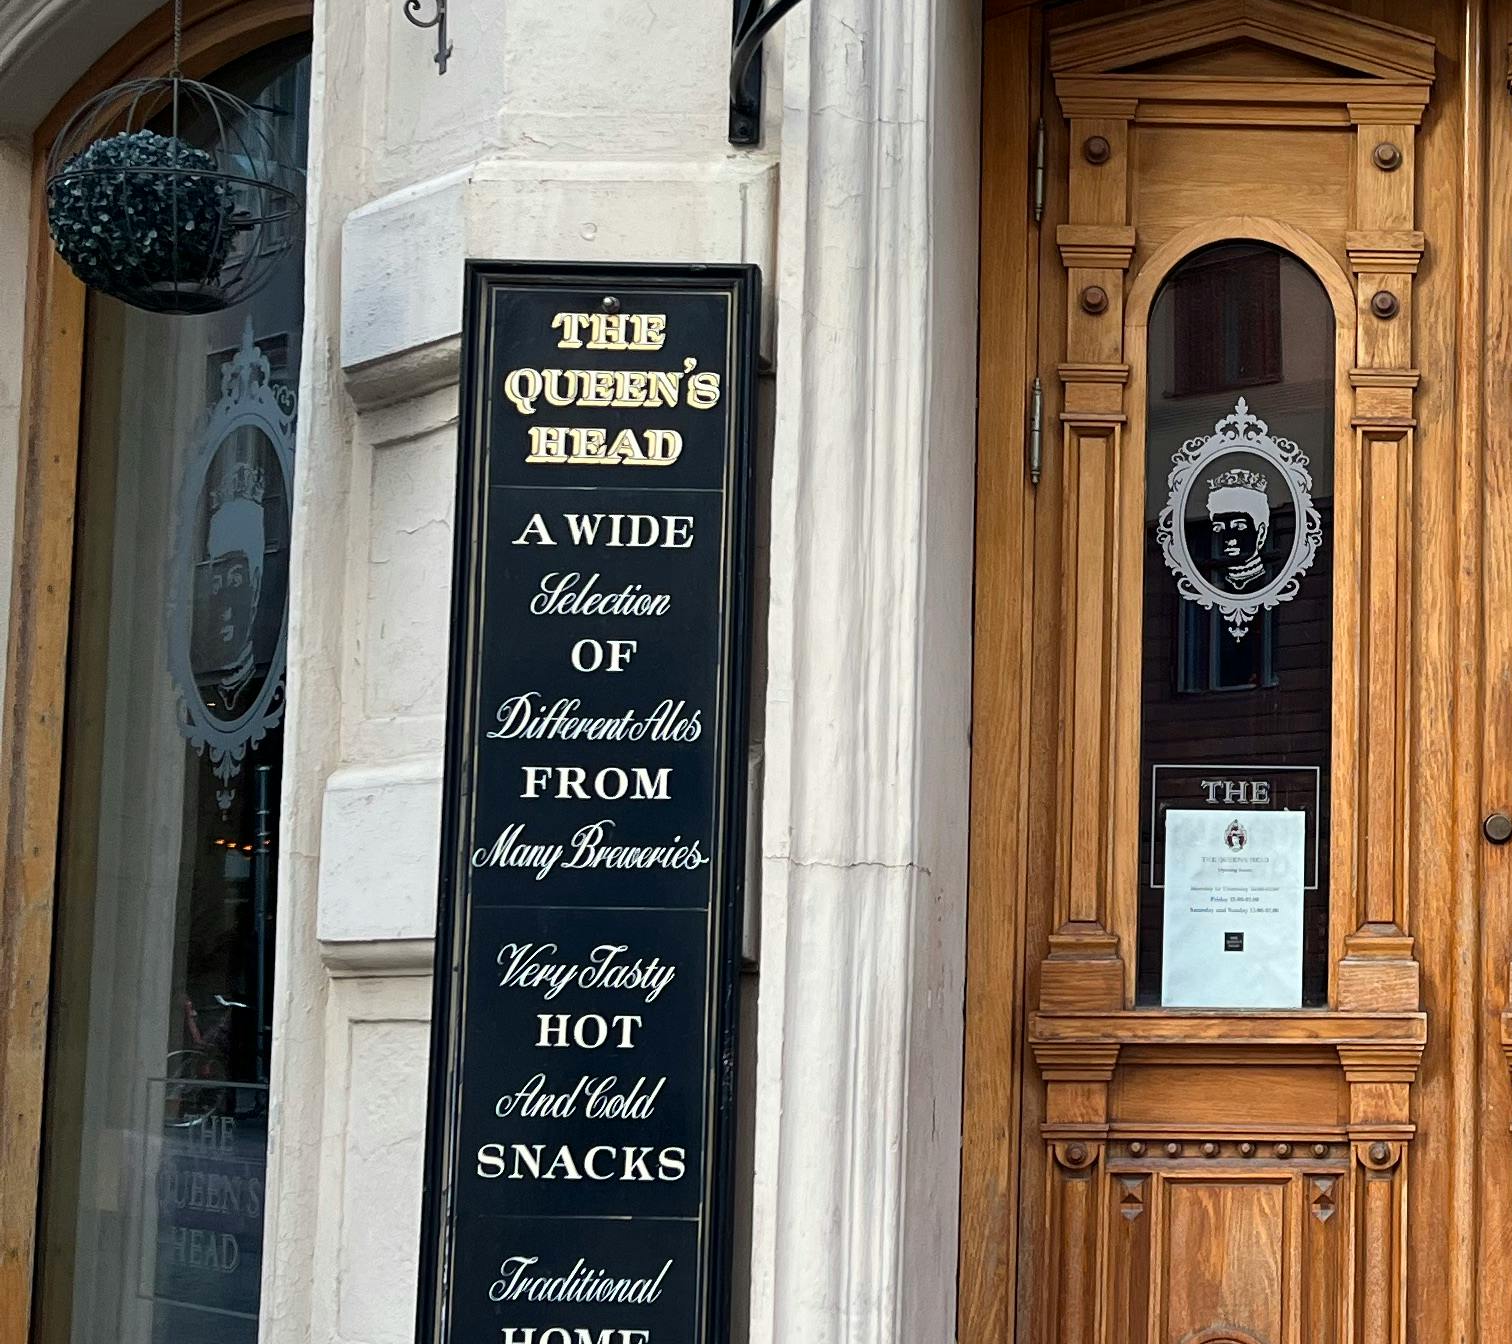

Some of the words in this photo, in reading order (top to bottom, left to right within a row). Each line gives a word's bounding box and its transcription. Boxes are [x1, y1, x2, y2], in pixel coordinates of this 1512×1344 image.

[551, 312, 666, 351] THE
[504, 357, 721, 415] QUEEN'S
[524, 426, 684, 467] HEAD
[511, 513, 557, 547] A
[564, 513, 694, 548] WIDE
[529, 571, 671, 618] Selection
[570, 638, 637, 673] OF
[486, 690, 640, 743] Different
[632, 698, 702, 743] Ales
[519, 767, 672, 801] FROM
[1201, 780, 1271, 805] THE
[471, 821, 562, 881] Many
[561, 819, 709, 871] Breweries
[496, 942, 579, 1000] Very
[578, 944, 676, 1003] Tasty
[535, 1014, 643, 1049] HOT
[494, 1072, 591, 1120] And
[584, 1074, 667, 1121] Cold
[476, 1142, 687, 1182] SNACKS
[488, 1255, 674, 1305] Traditional
